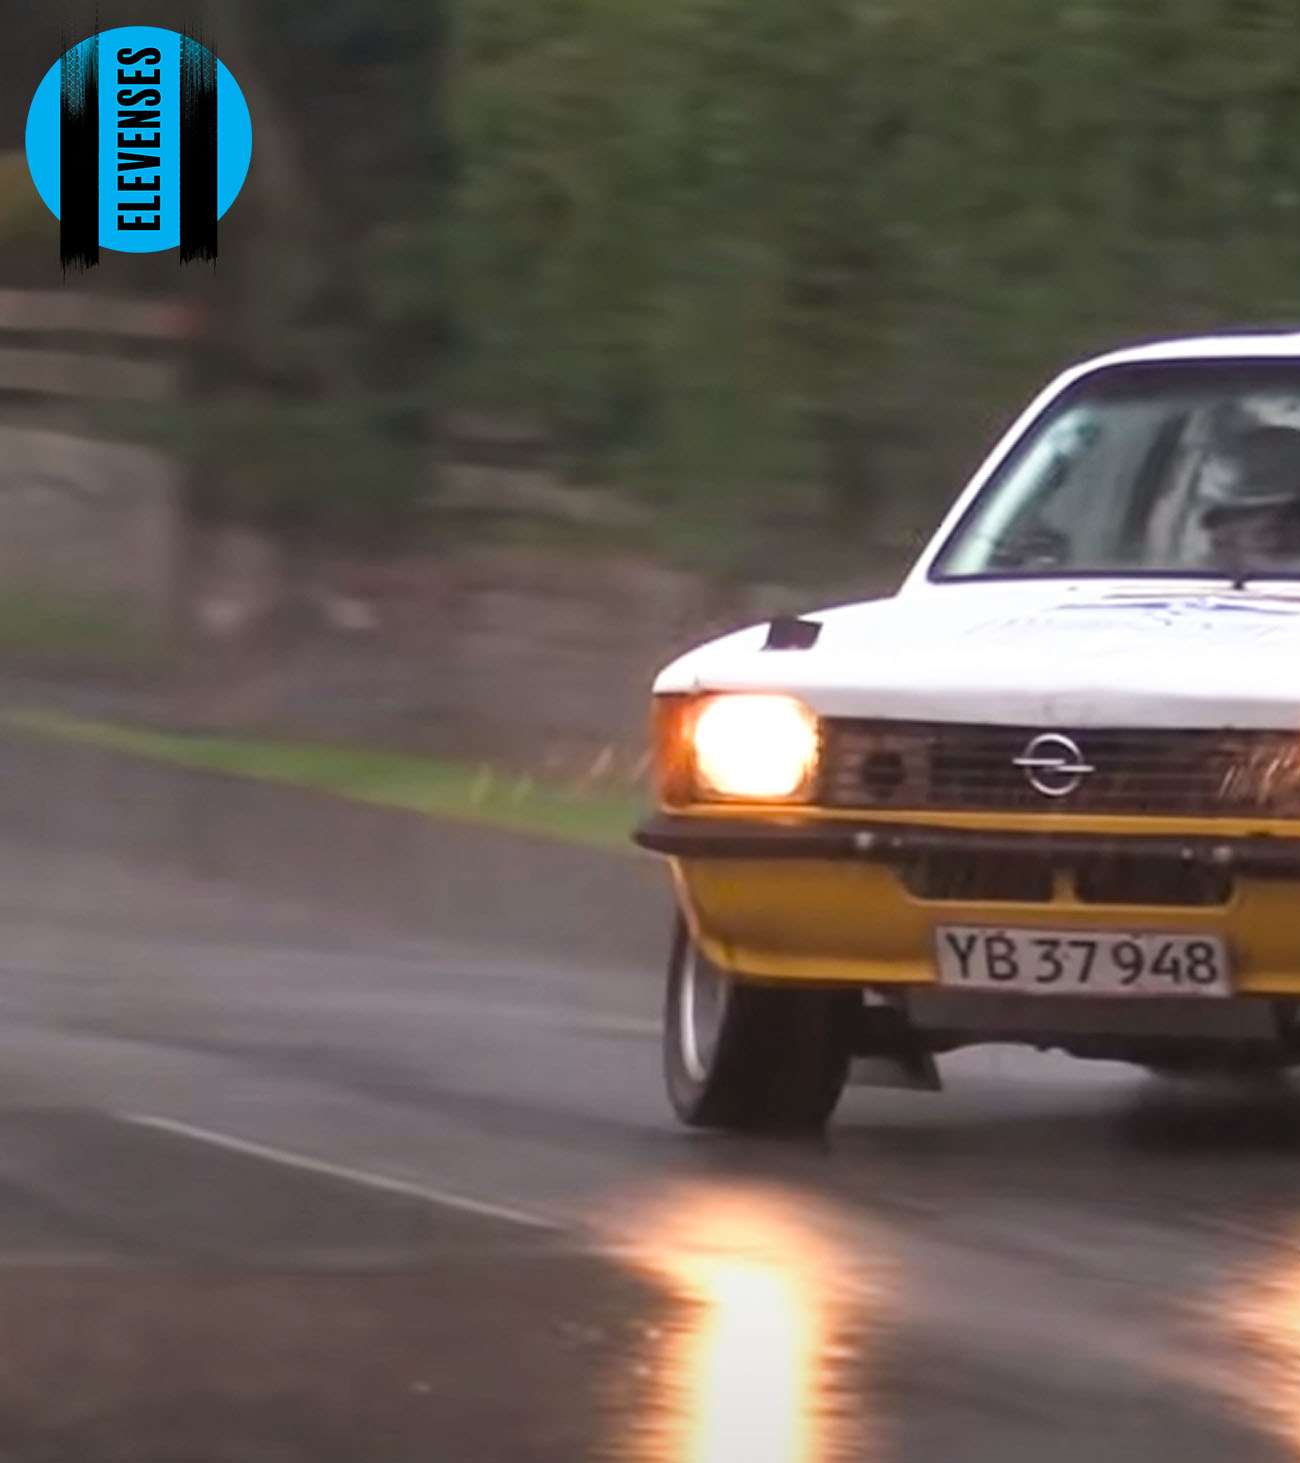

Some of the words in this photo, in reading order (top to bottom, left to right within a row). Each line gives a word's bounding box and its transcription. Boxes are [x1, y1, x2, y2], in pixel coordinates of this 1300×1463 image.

[945, 932, 1019, 982] YB
[1030, 938, 1098, 984] 37
[1110, 940, 1218, 985] 948
